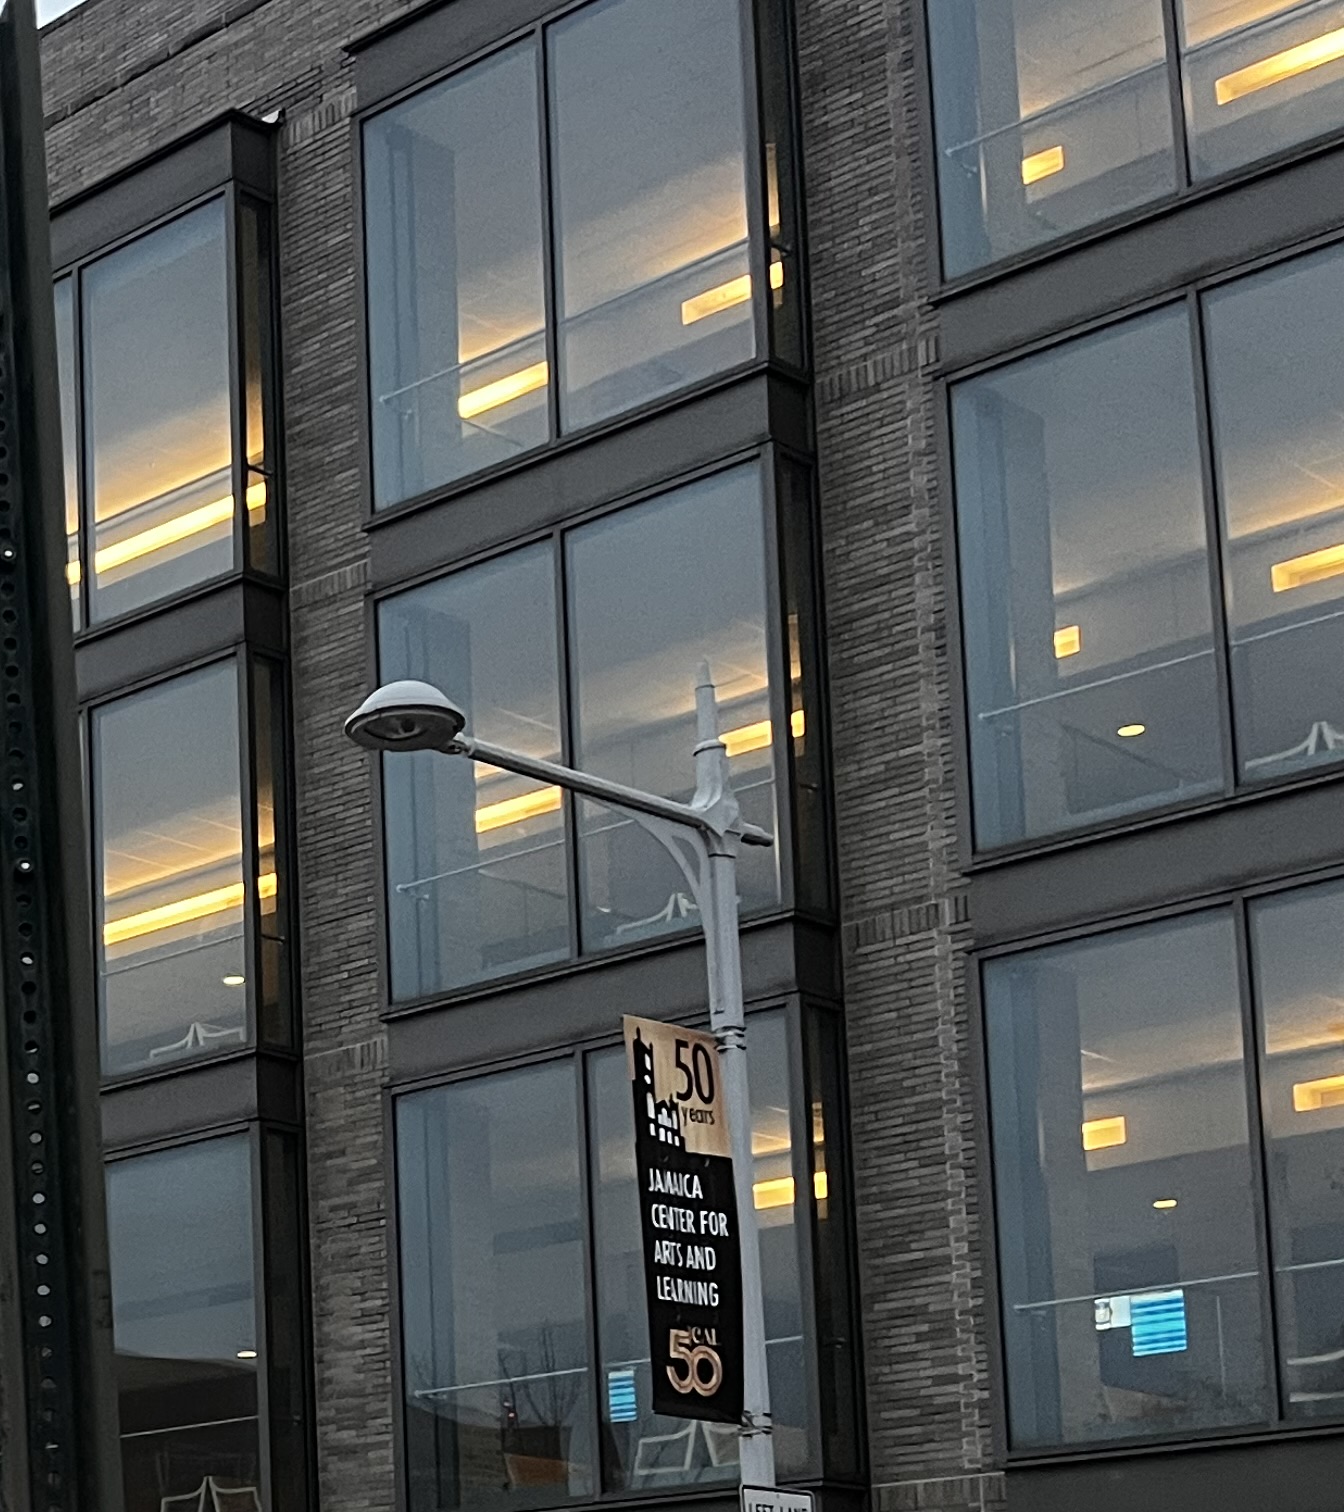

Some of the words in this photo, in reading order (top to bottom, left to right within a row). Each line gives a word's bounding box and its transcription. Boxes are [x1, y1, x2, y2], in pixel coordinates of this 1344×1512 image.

[675, 1038, 715, 1105] 50
[681, 1106, 715, 1126] years
[648, 1167, 704, 1200] JAMAICA
[650, 1203, 696, 1235] CENTER
[699, 1210, 730, 1237] FOR
[654, 1239, 684, 1267] ARTS
[686, 1245, 717, 1271] AND
[656, 1275, 720, 1307] LEARNING
[665, 1328, 723, 1397] 50
